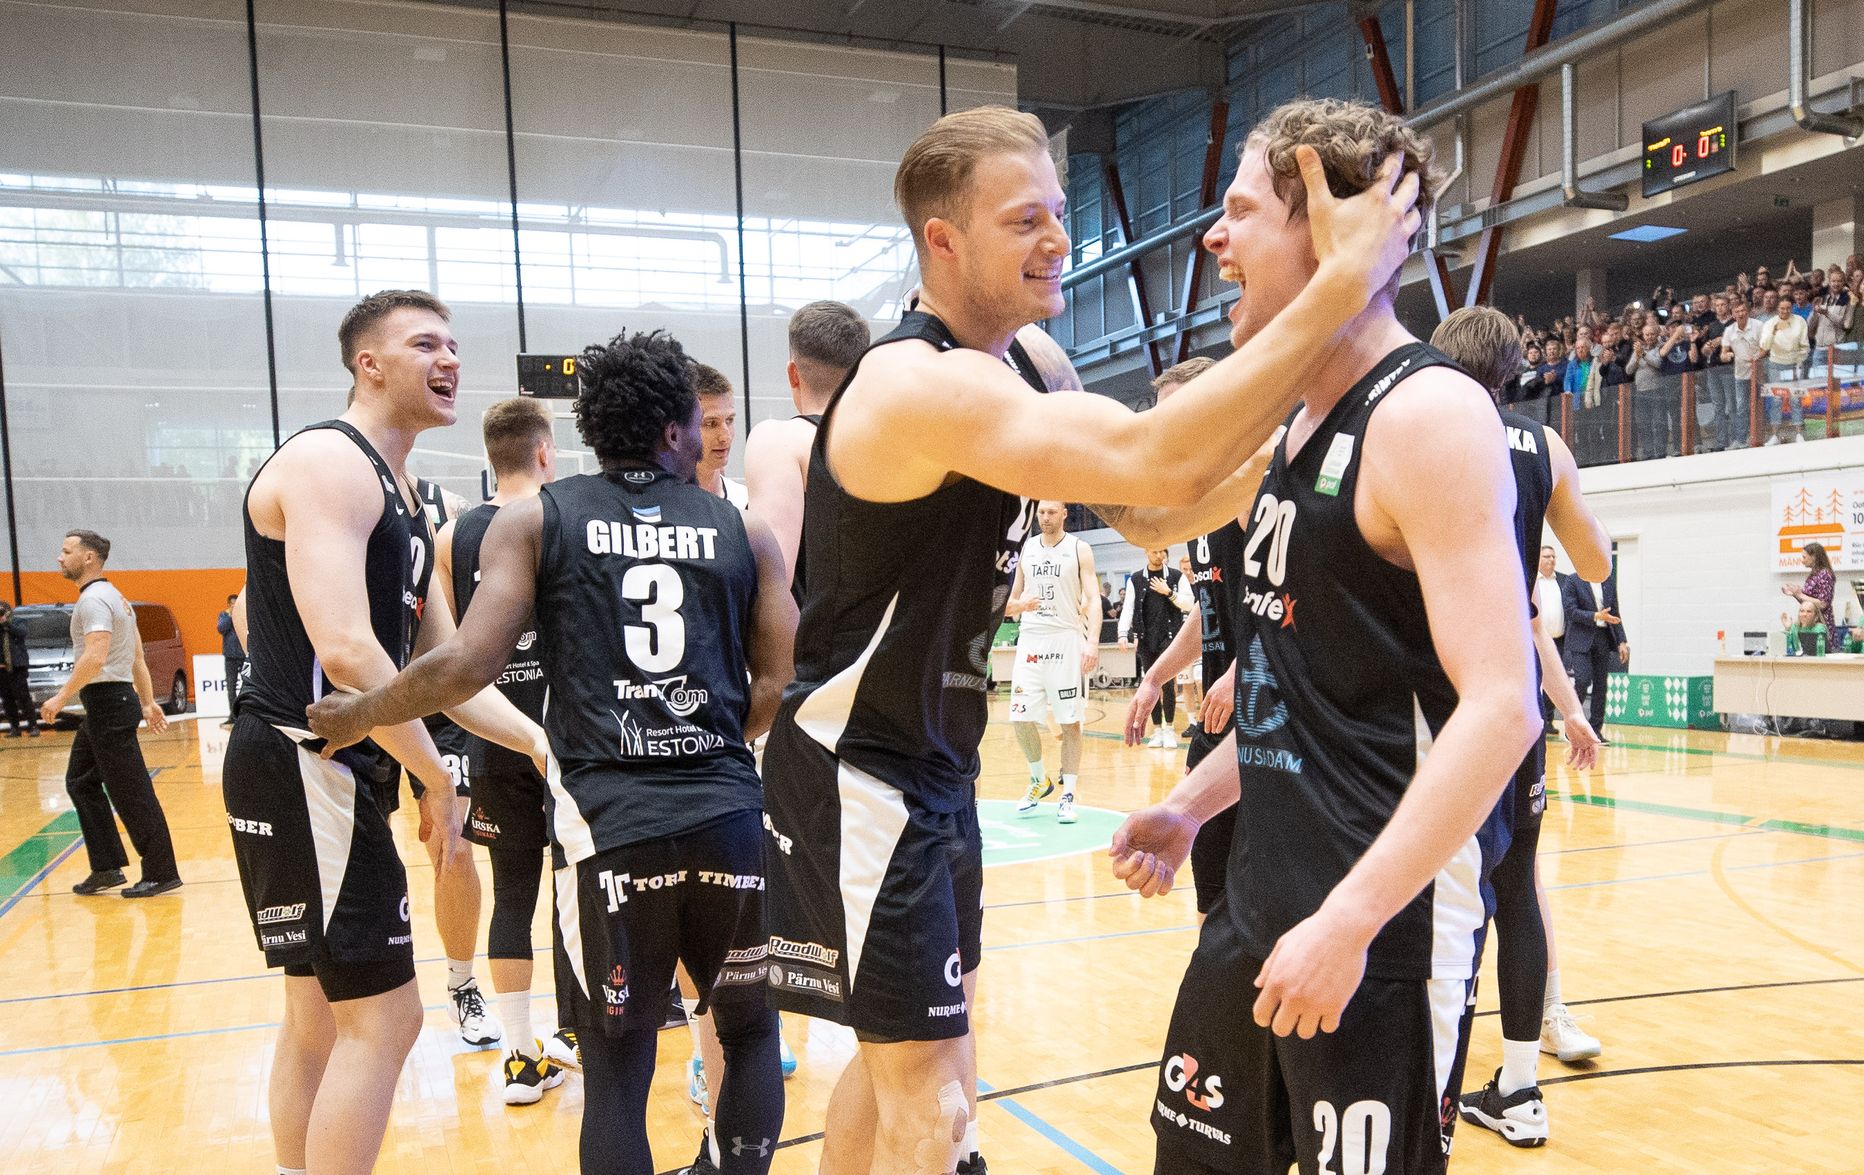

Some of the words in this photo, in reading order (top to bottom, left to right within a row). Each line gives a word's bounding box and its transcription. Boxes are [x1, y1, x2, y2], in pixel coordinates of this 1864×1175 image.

[1504, 425, 1538, 455] KA
[586, 519, 718, 560] GILBERT
[1244, 493, 1297, 587] 20
[1031, 563, 1062, 578] TARTU
[621, 563, 686, 674] 3
[646, 726, 675, 738] Resort
[647, 734, 725, 757] ESTONIA
[633, 869, 688, 892] TORI
[285, 929, 307, 941] Vesi
[786, 971, 822, 988] Pärnu
[822, 977, 840, 995] Vesi
[928, 1003, 961, 1018] NURME
[1164, 1052, 1225, 1113] G4S
[1188, 1117, 1232, 1146] TURVAS
[1312, 1099, 1392, 1175] 20
